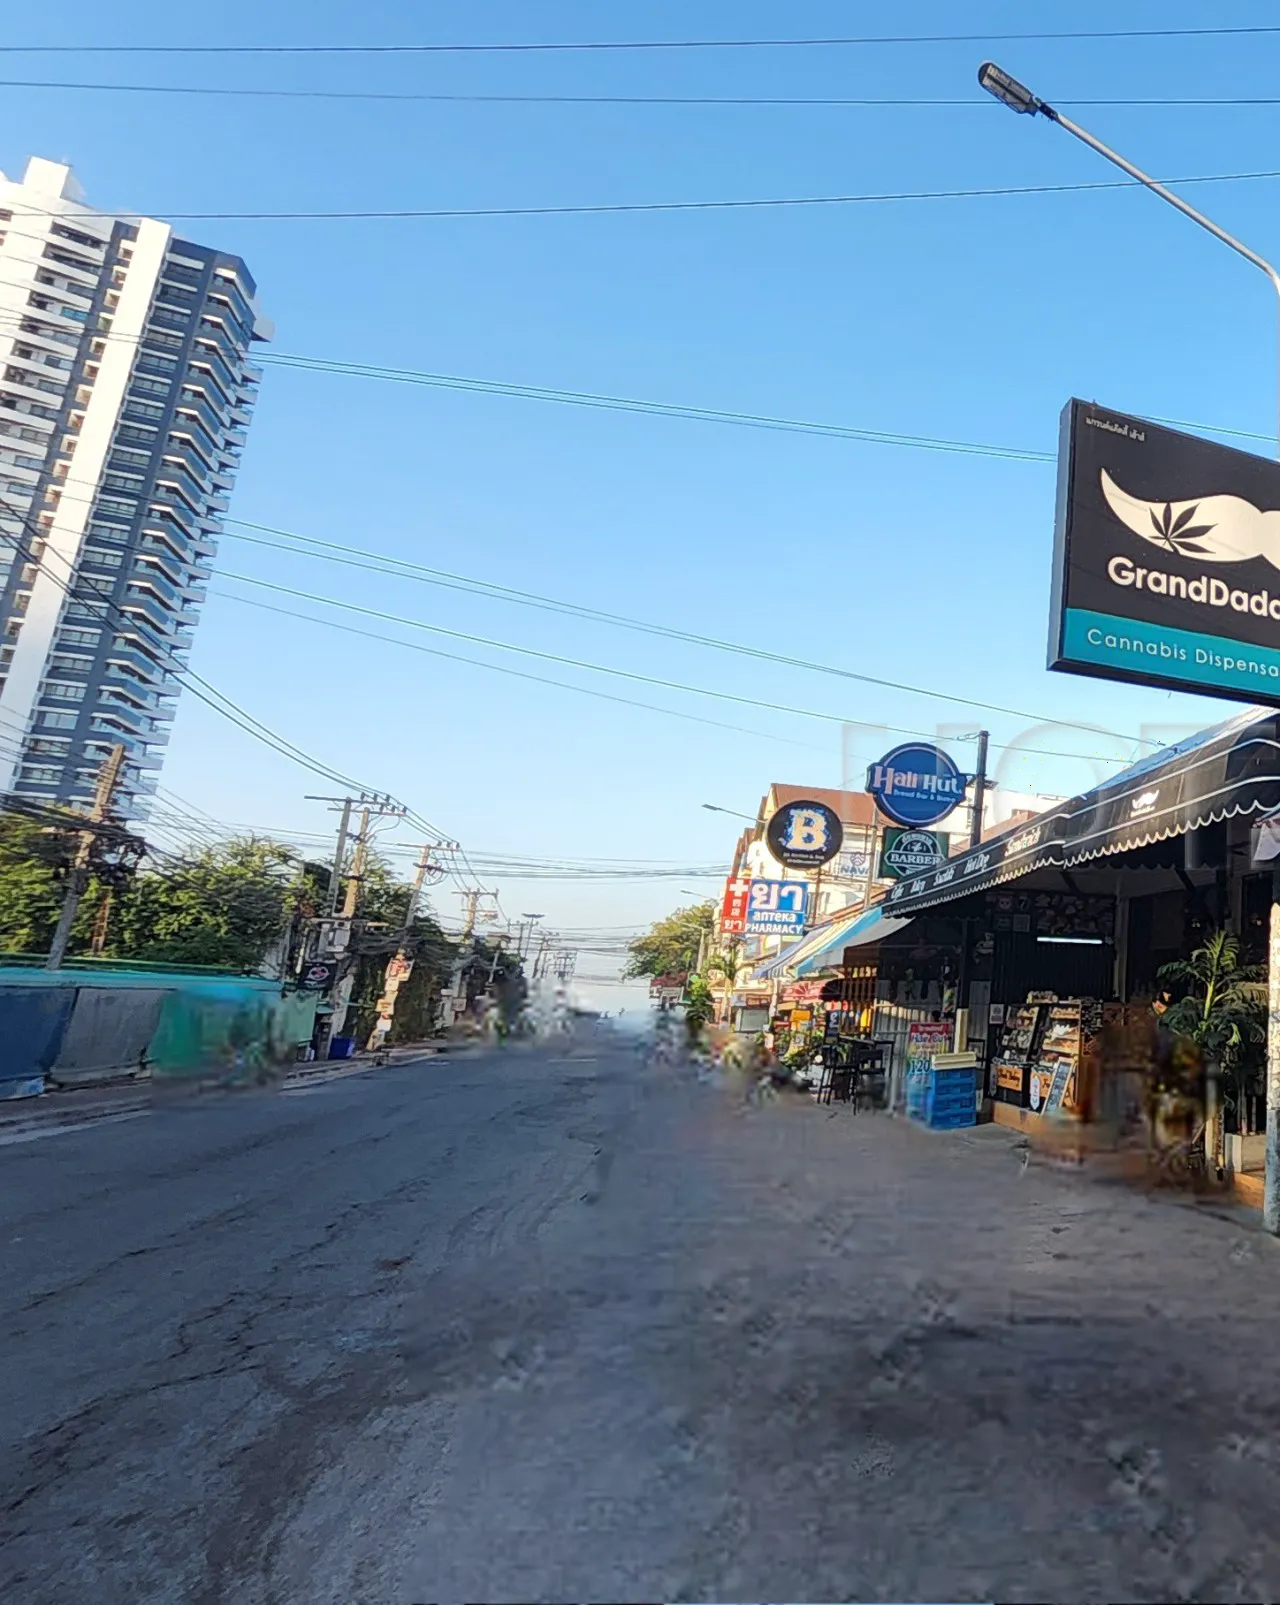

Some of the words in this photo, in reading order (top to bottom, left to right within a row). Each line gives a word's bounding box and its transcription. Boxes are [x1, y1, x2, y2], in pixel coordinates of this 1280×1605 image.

[1087, 628, 1187, 662] Cannabis
[891, 853, 942, 865] BARBER
[751, 883, 803, 911] ยา
[744, 922, 804, 934] PHARMACY
[911, 1060, 931, 1073] 120
